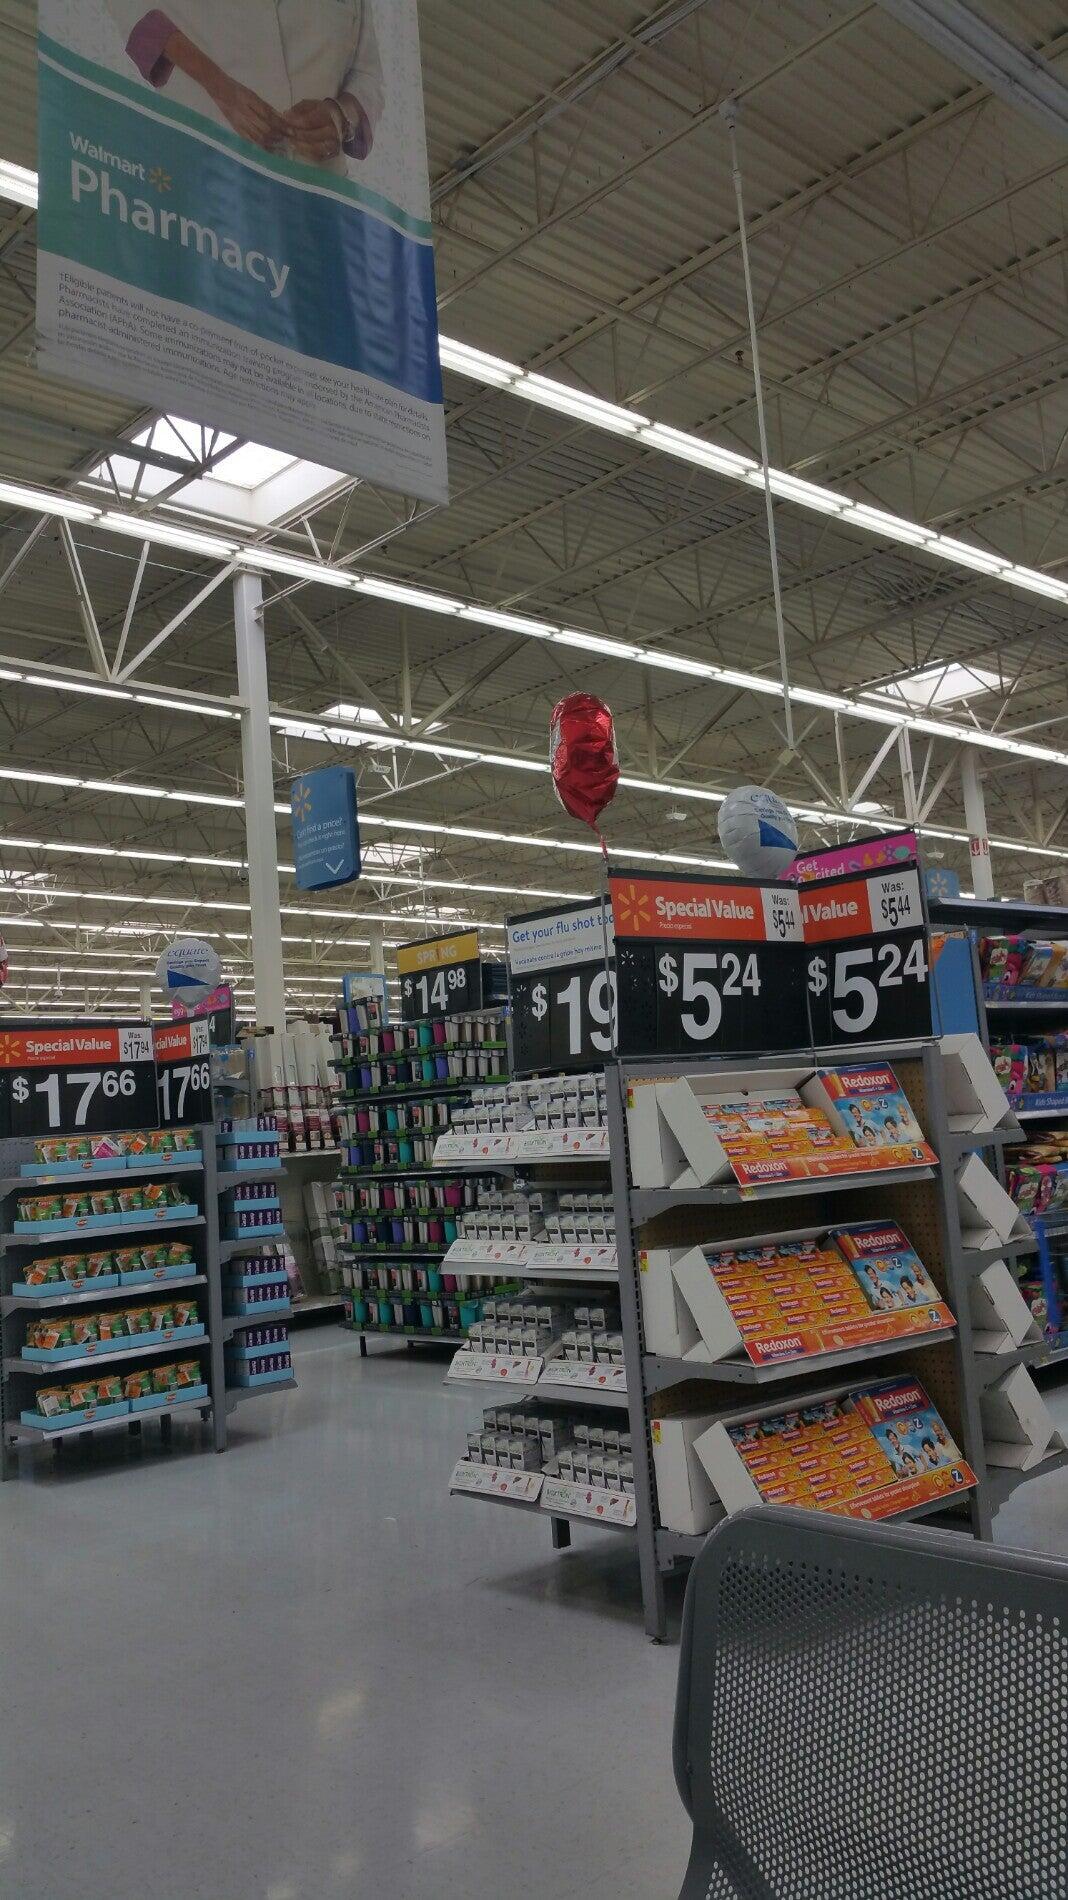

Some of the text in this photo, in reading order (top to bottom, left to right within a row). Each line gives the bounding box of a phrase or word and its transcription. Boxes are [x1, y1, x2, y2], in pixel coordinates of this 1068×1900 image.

[69, 131, 146, 181] Walmart
[71, 159, 290, 298] Pharmacy
[133, 313, 176, 334] completed
[130, 301, 143, 312] will
[145, 308, 158, 318] not
[333, 379, 349, 390] your
[140, 325, 163, 341] Some
[222, 358, 238, 371] may
[240, 364, 253, 375] not
[254, 370, 264, 379] be
[796, 860, 818, 875] Get
[881, 881, 905, 894] Was:
[655, 896, 754, 921] Special Value
[771, 893, 790, 907] Was:
[808, 900, 859, 923] Value
[512, 930, 530, 943] Get
[531, 926, 554, 944] your
[555, 920, 570, 934] flu
[572, 916, 595, 932] shot
[25, 1037, 112, 1056] Special Value
[168, 1034, 187, 1048] Value
[841, 1073, 891, 1089] Redoxon
[741, 1160, 788, 1175] Redoxon
[853, 1233, 901, 1250] Redoxon
[754, 1336, 803, 1355] Redoxon
[873, 1389, 922, 1412] Redoxon
